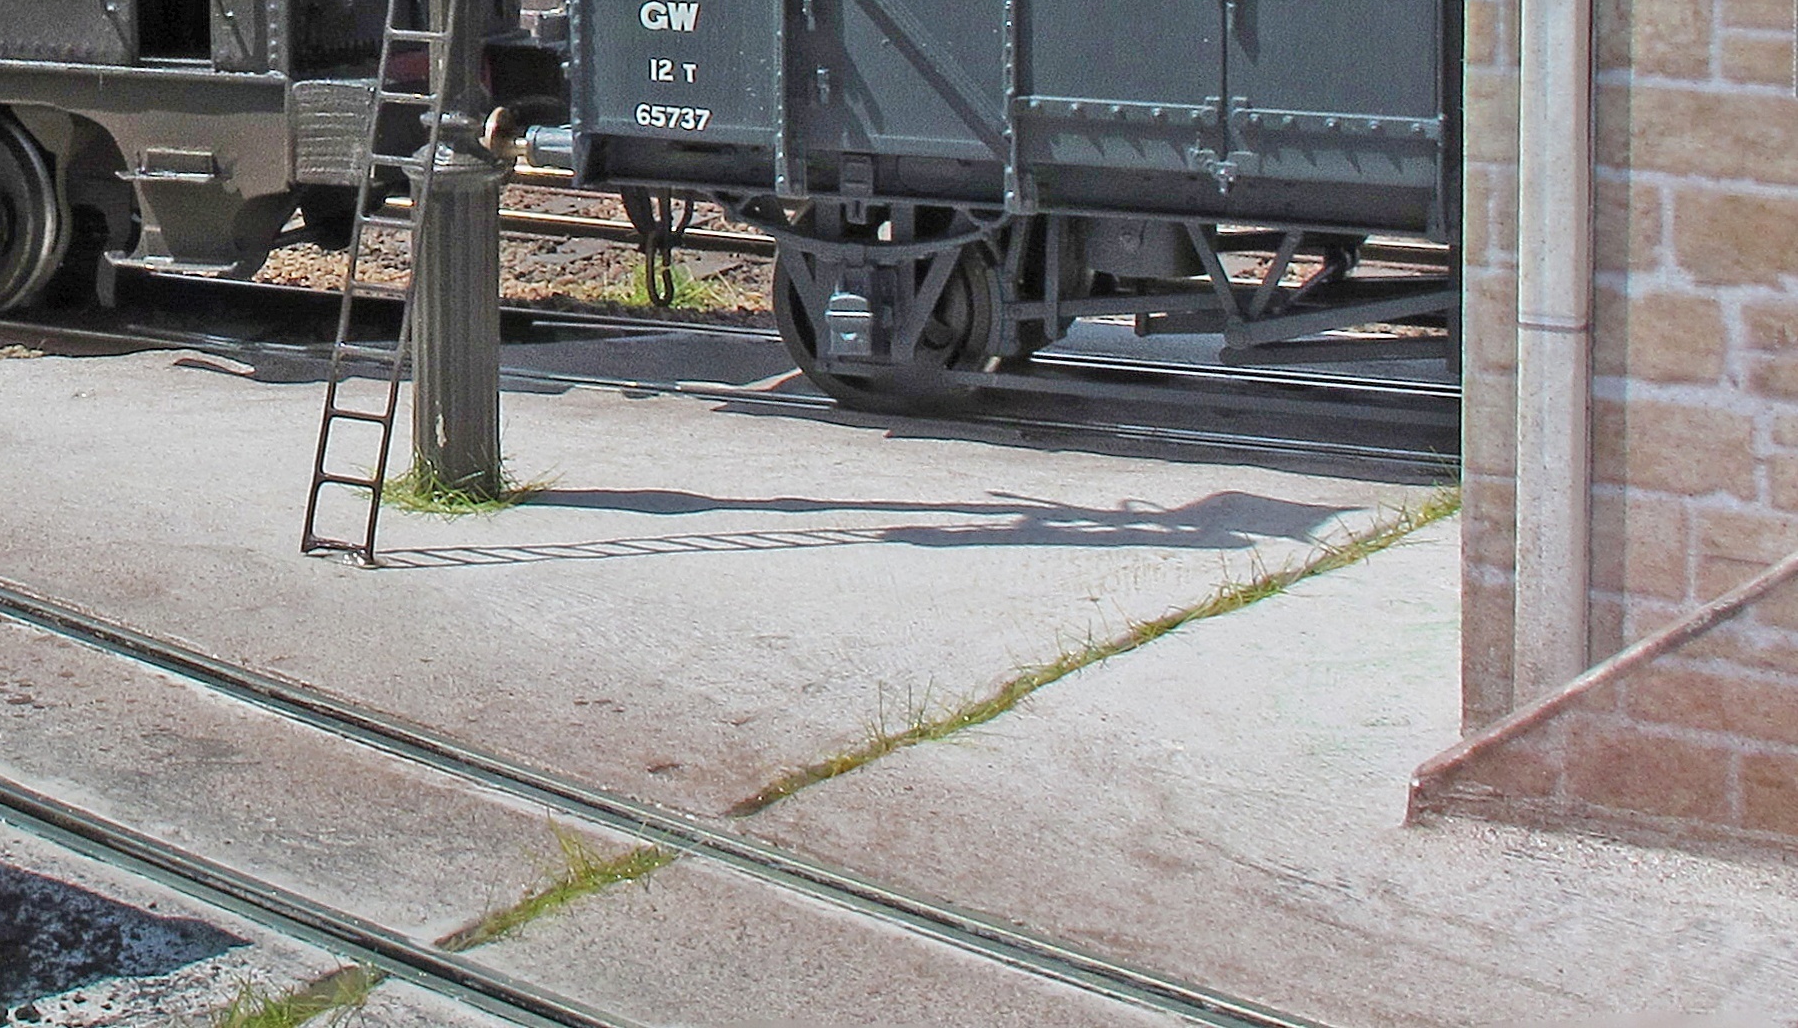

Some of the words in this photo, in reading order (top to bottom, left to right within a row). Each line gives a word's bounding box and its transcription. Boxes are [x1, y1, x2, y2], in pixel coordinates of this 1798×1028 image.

[639, 0, 700, 32] GW
[649, 58, 674, 82] 12
[682, 63, 698, 83] T
[635, 103, 712, 131] 65737
